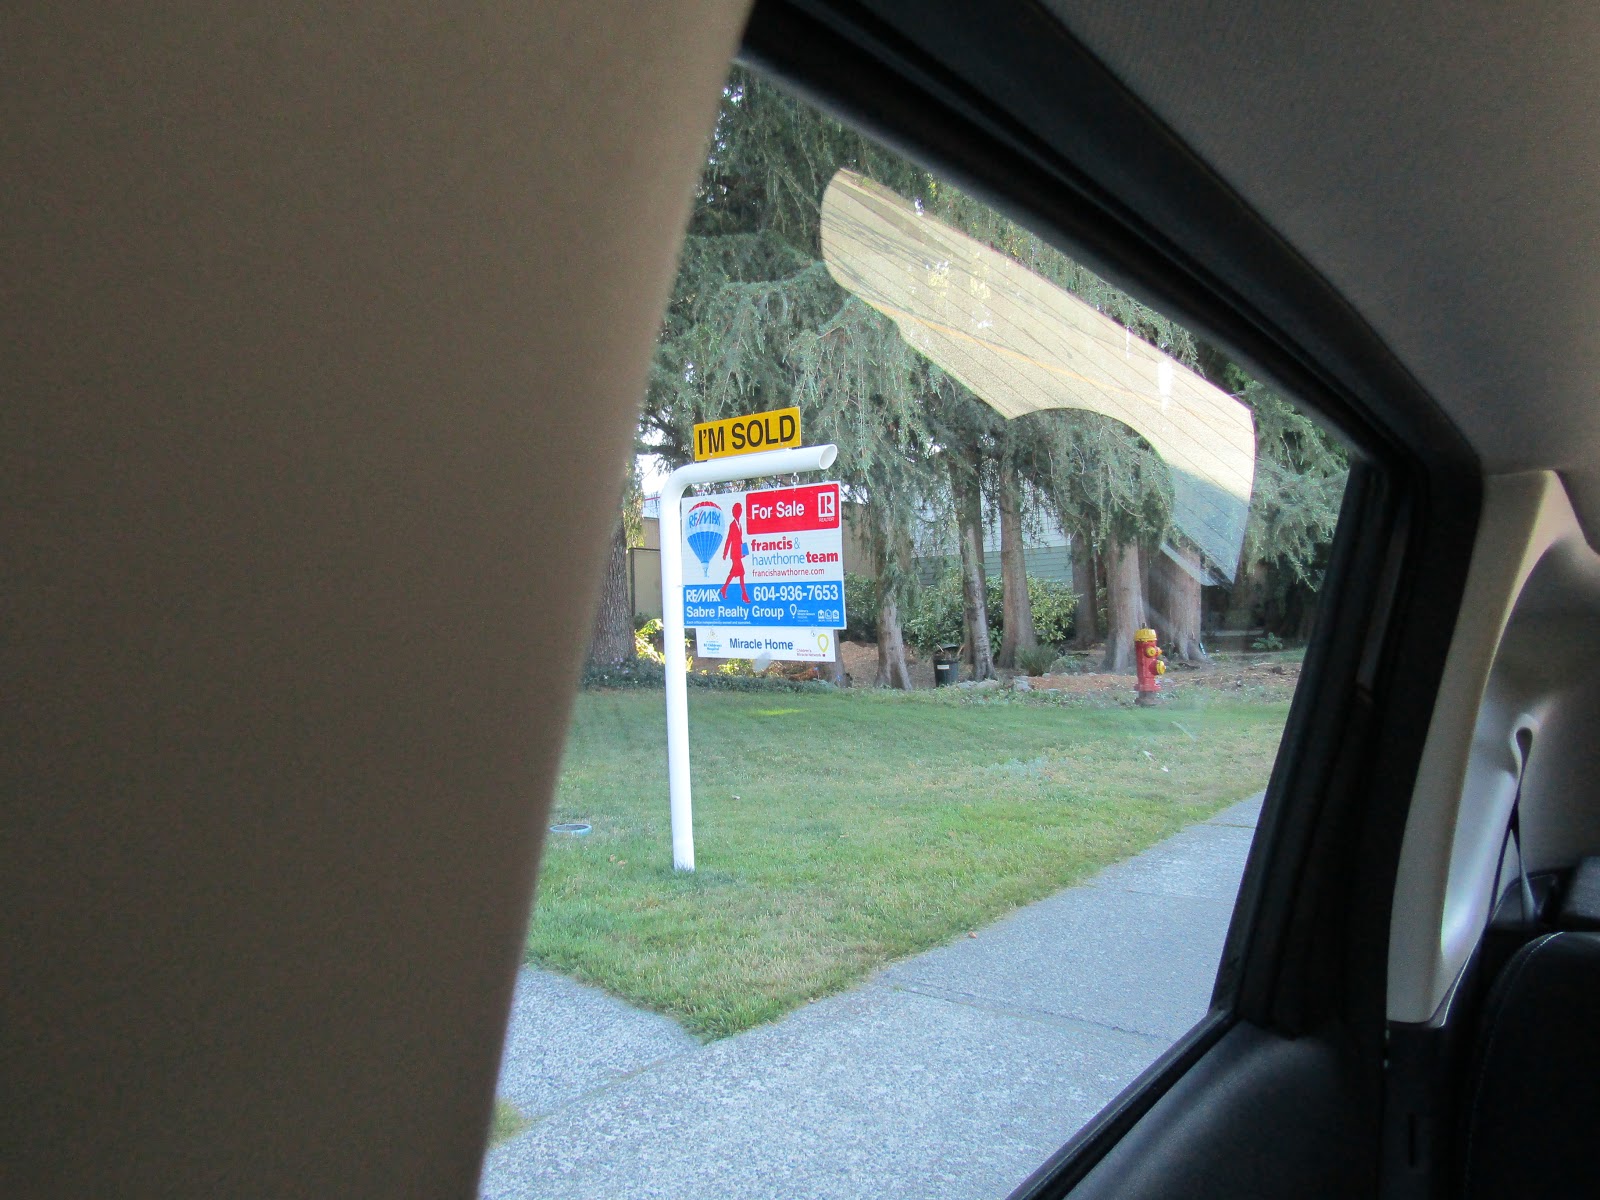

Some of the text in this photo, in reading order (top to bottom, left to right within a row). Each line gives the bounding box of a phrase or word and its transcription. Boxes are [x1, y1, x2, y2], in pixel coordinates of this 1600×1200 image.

[698, 414, 796, 455] I'M SOLD
[751, 500, 805, 520] For Sale
[688, 510, 721, 528] RE/MAX
[751, 536, 793, 552] francis
[752, 567, 825, 577] francishawthorne.com
[685, 584, 839, 603] RE/MAX 604-936-7653
[686, 605, 716, 618] Sabre
[718, 605, 749, 620] Realty
[751, 605, 785, 620] Group
[729, 637, 794, 650] Miracle Home
